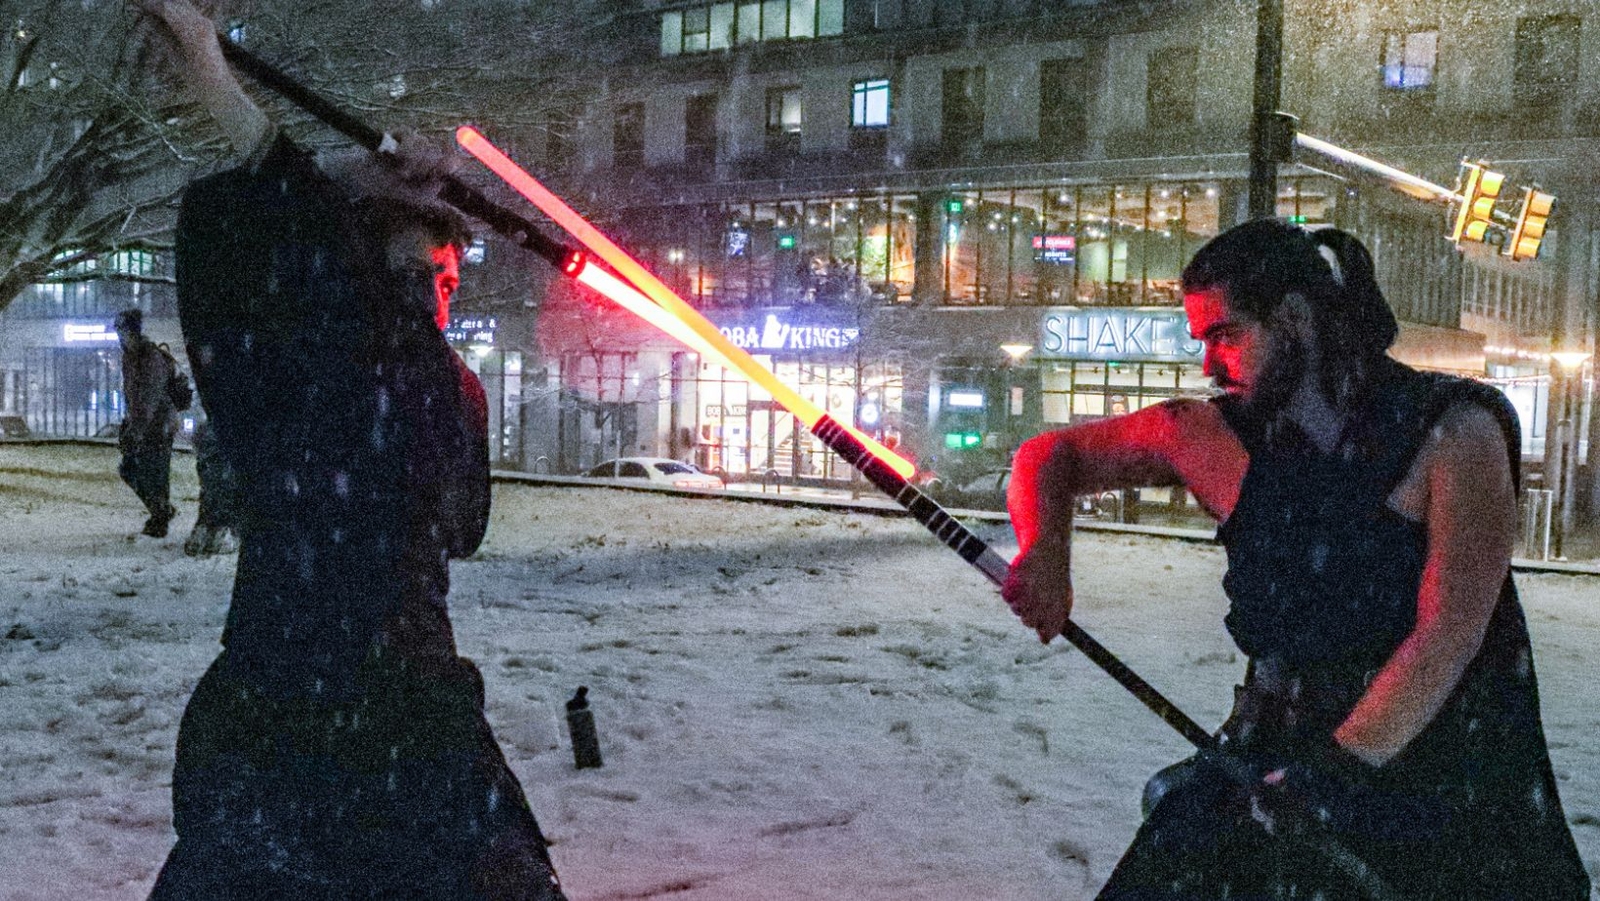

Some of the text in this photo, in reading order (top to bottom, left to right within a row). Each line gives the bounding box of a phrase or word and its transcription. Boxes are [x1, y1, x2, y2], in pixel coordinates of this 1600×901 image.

[719, 326, 841, 349] OBA KING
[1043, 315, 1177, 356] SHAKE
